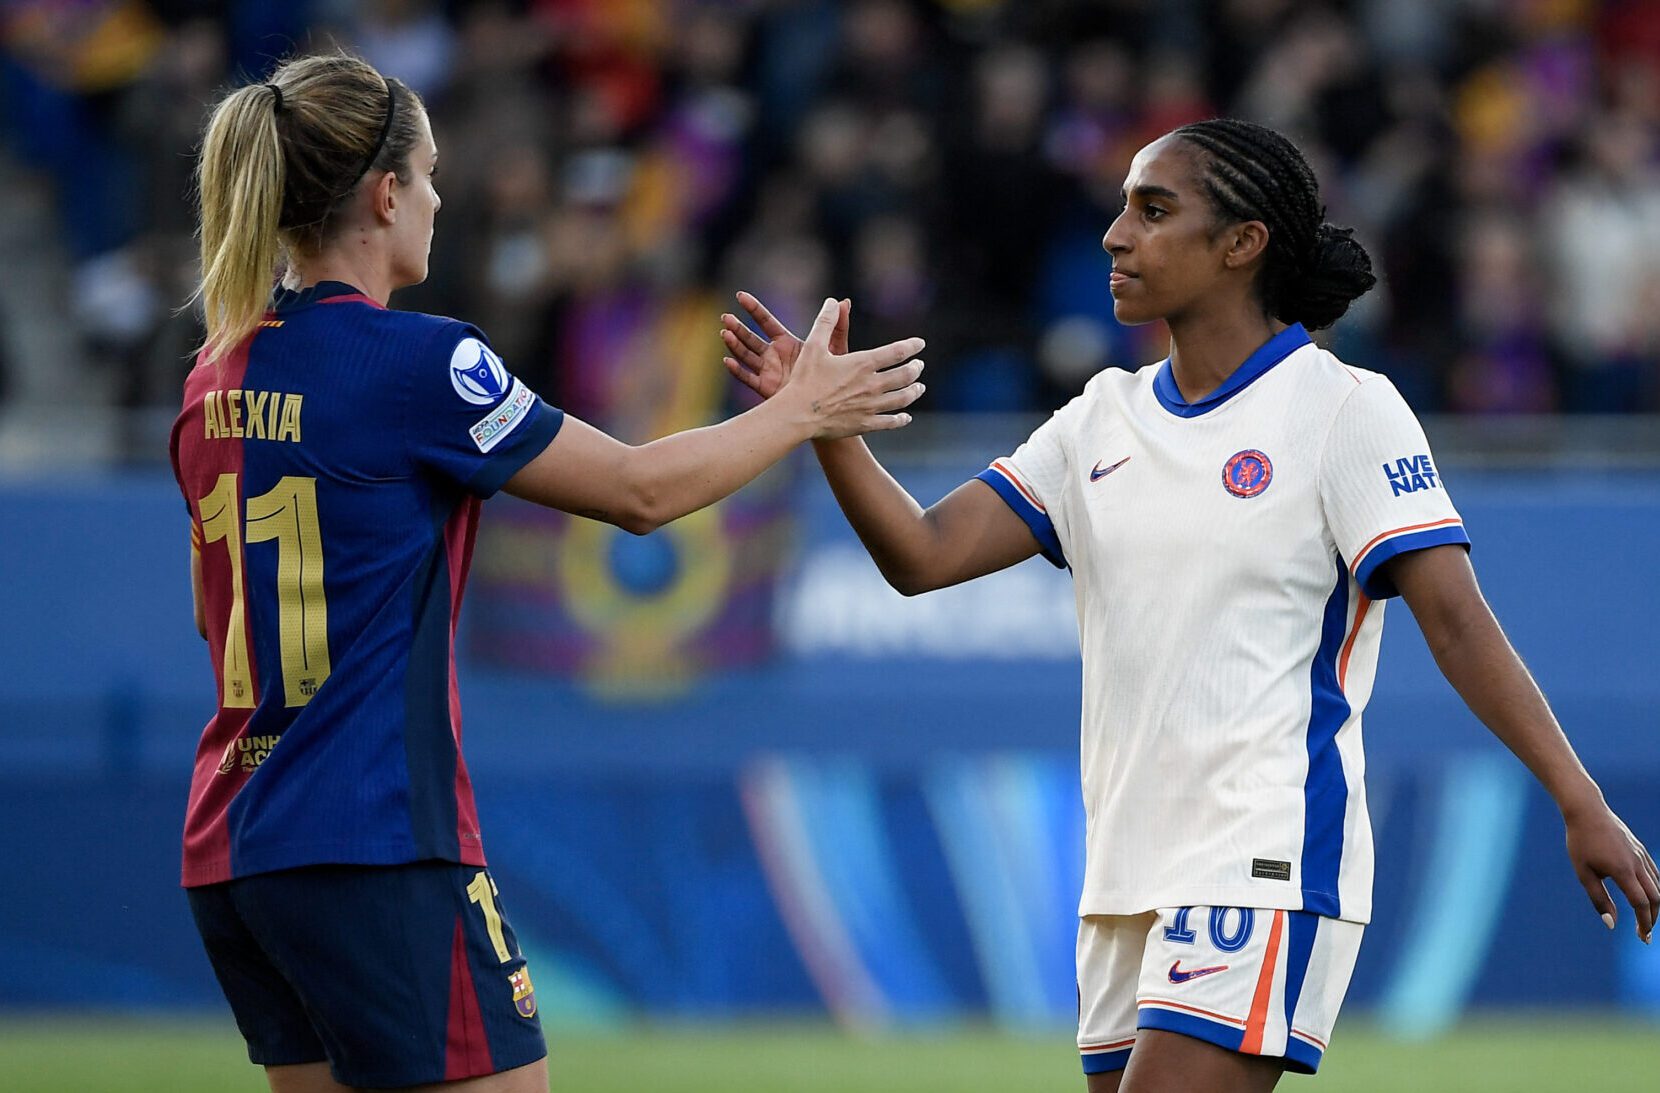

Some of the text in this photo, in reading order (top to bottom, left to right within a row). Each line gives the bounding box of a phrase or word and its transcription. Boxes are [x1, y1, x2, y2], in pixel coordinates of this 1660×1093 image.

[204, 389, 304, 443] ALEXIA
[1382, 455, 1433, 480] LIVE
[200, 473, 332, 708] 11
[241, 750, 271, 766] AC
